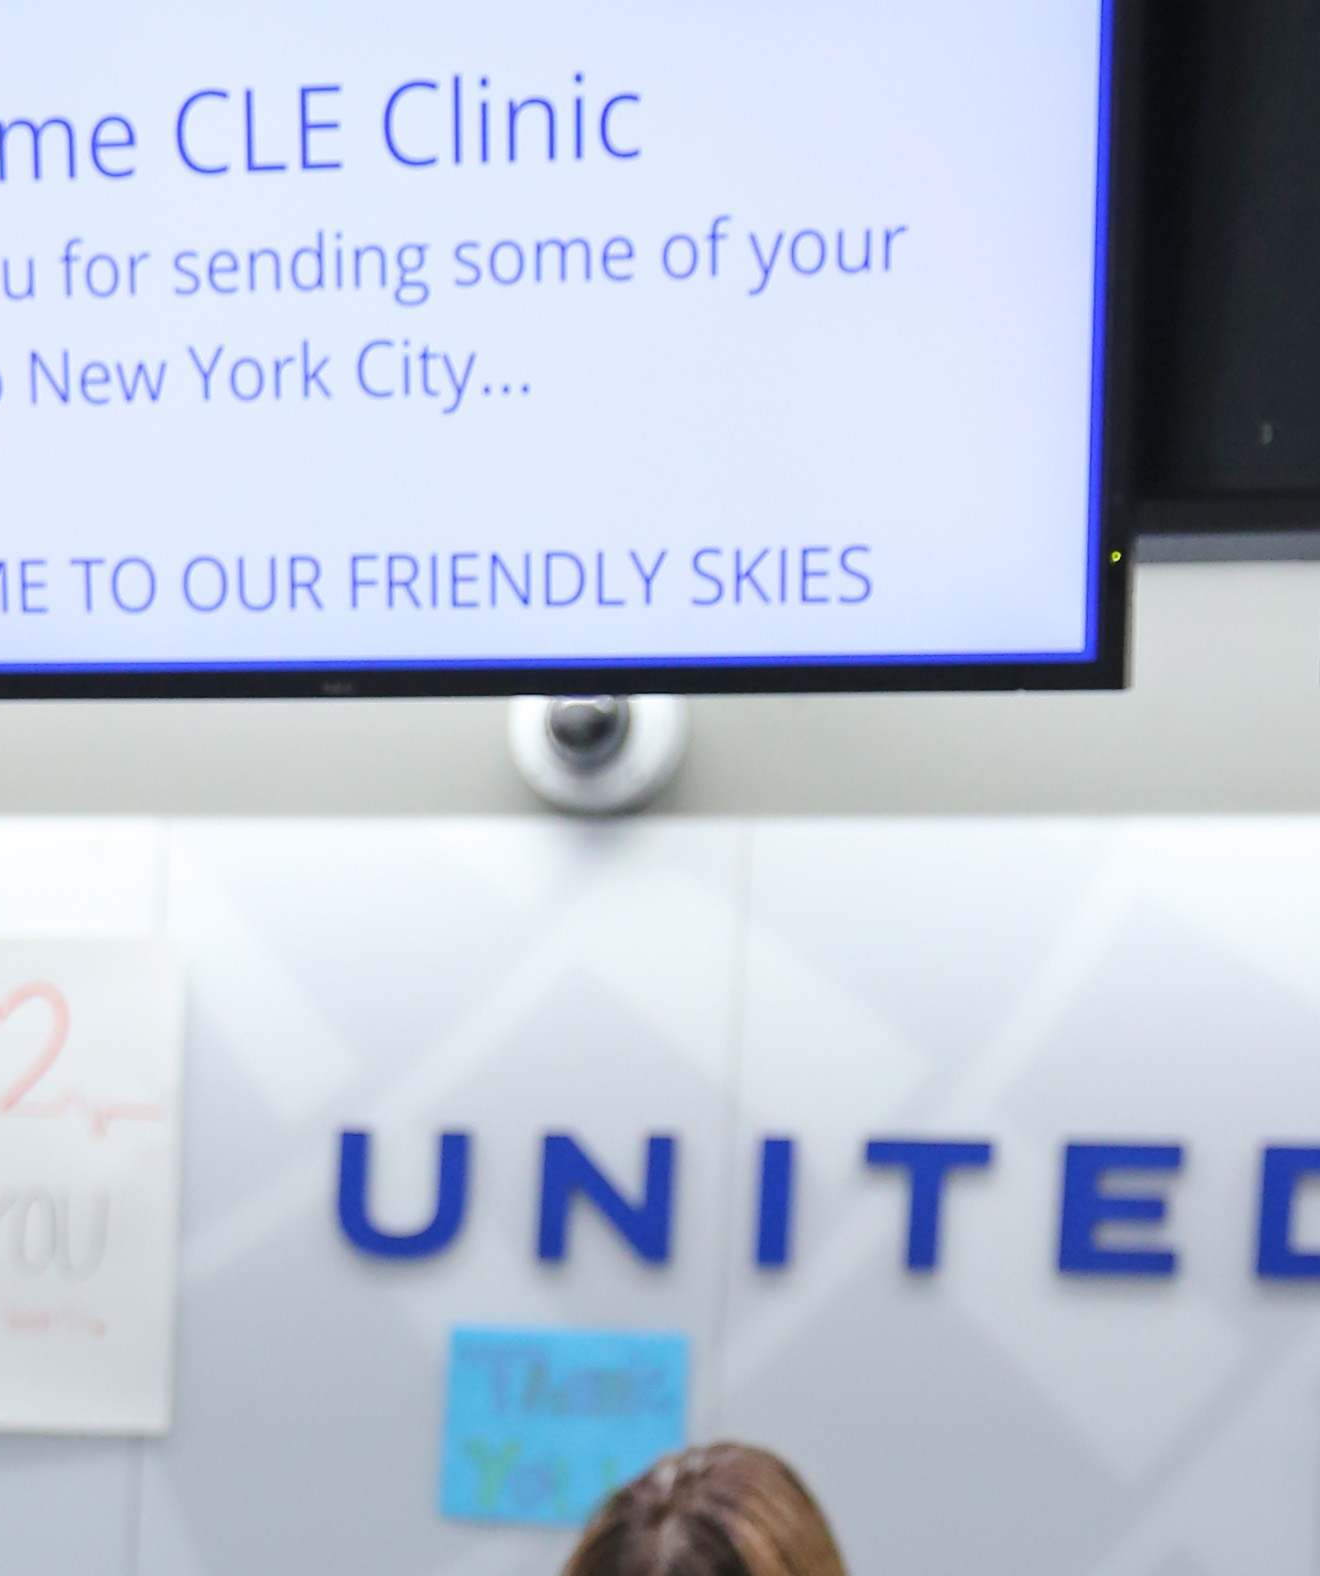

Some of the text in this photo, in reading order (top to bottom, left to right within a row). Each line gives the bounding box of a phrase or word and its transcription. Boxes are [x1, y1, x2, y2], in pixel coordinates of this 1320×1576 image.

[174, 84, 344, 177] CLE
[382, 72, 642, 167] Clinic
[60, 237, 151, 299] for
[172, 229, 430, 306] sending
[452, 228, 637, 288] some
[661, 215, 732, 280] of
[747, 222, 909, 295] your
[30, 349, 168, 404] New
[187, 340, 333, 402] York
[355, 339, 531, 414] City...
[70, 554, 157, 614] TO
[181, 553, 325, 613] OUR
[350, 549, 669, 610] FRIENDLY
[690, 543, 874, 605] SKIES
